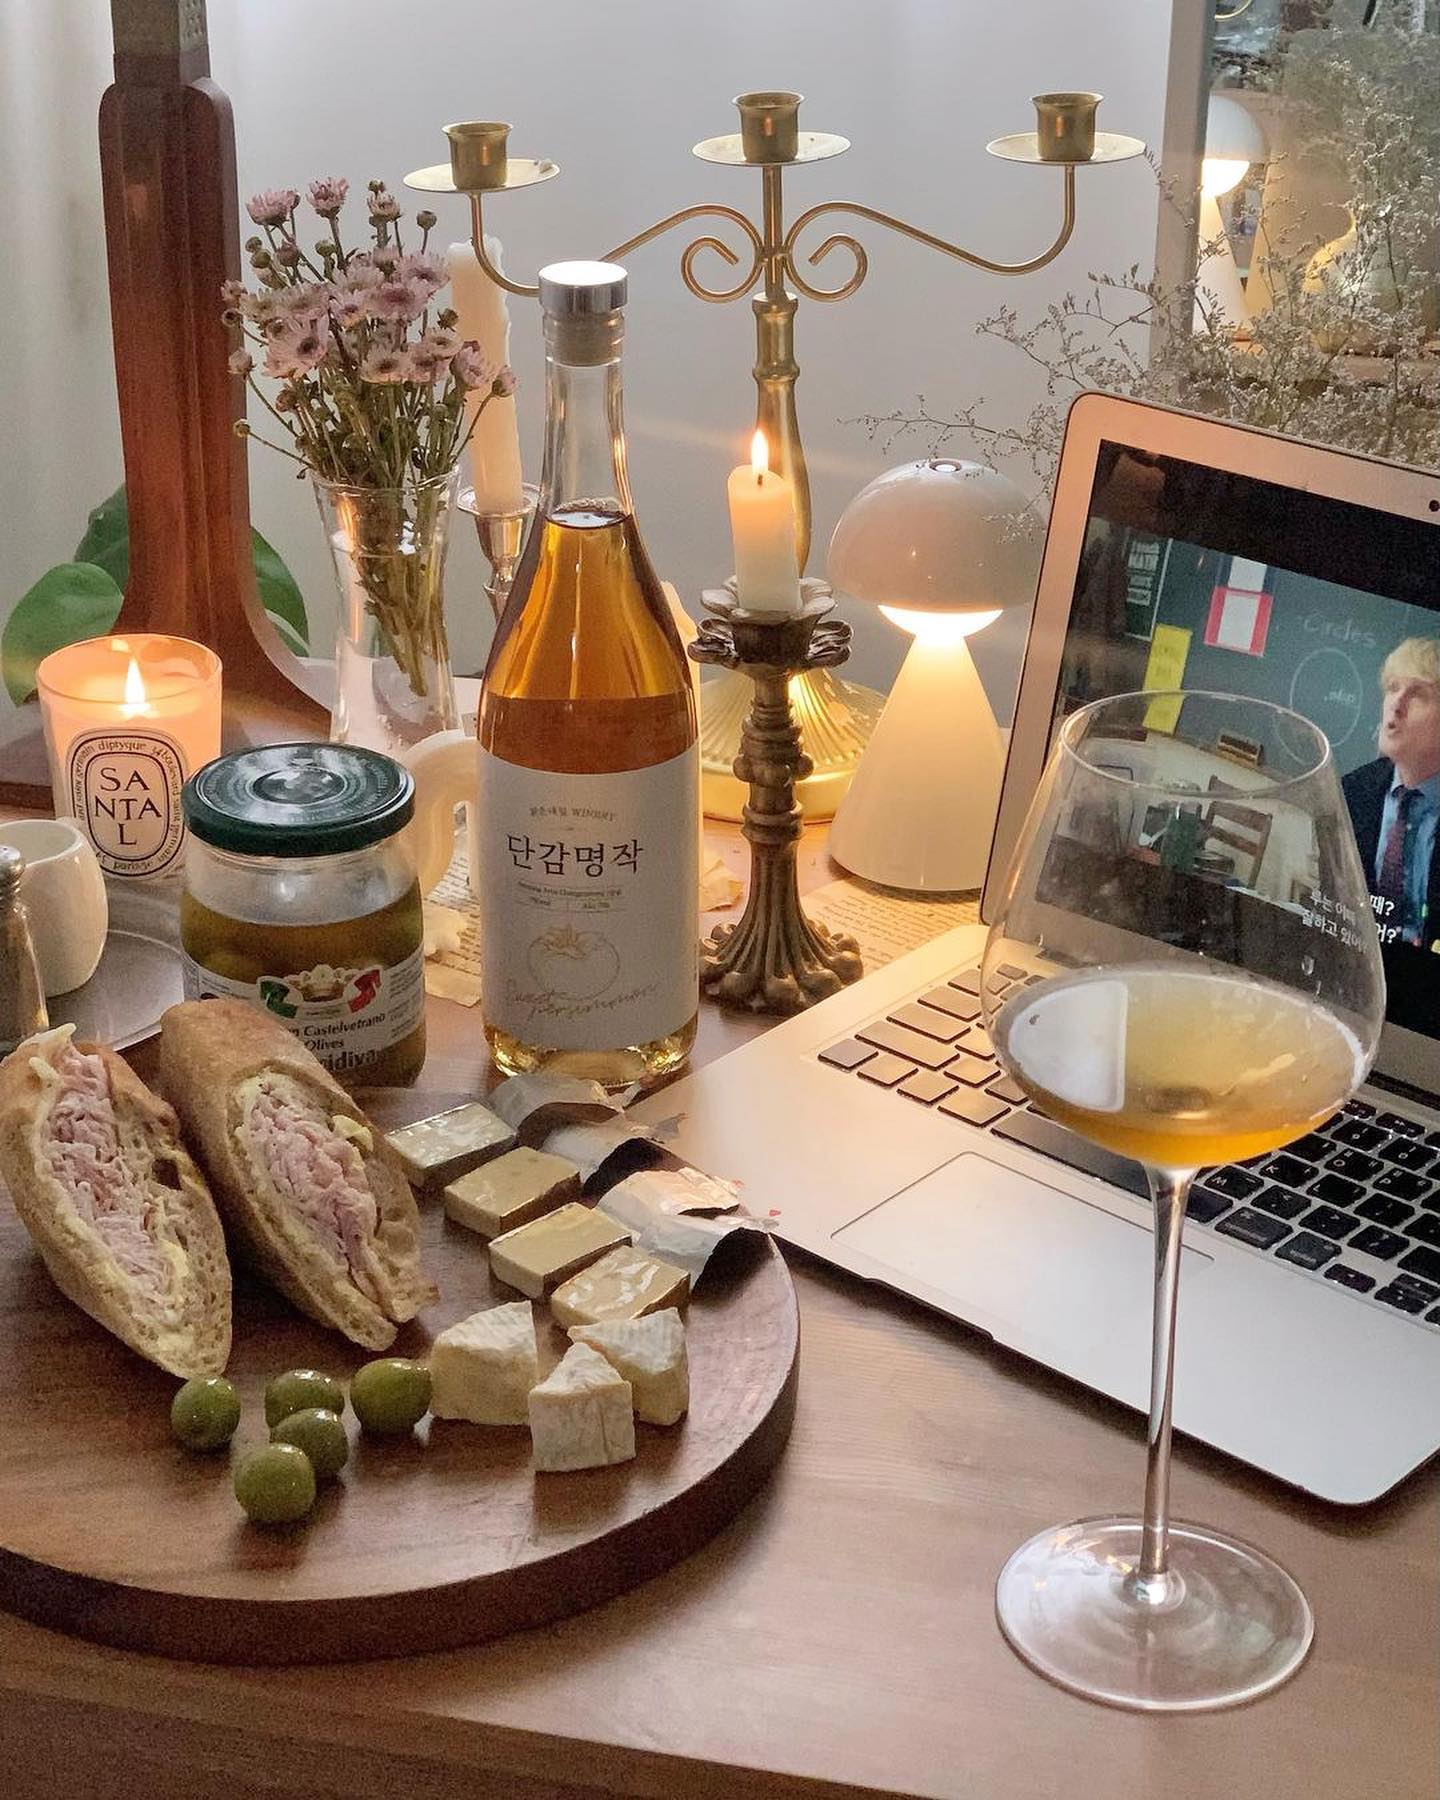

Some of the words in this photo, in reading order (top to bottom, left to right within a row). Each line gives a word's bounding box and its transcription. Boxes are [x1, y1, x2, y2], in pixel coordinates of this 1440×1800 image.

[98, 740, 147, 752] diptyque
[99, 766, 150, 792] SA
[94, 795, 162, 821] NTA
[117, 822, 138, 846] L
[506, 833, 644, 878] 단감명작
[303, 1012, 386, 1037] Castelvetrano
[304, 1039, 345, 1051] Olives
